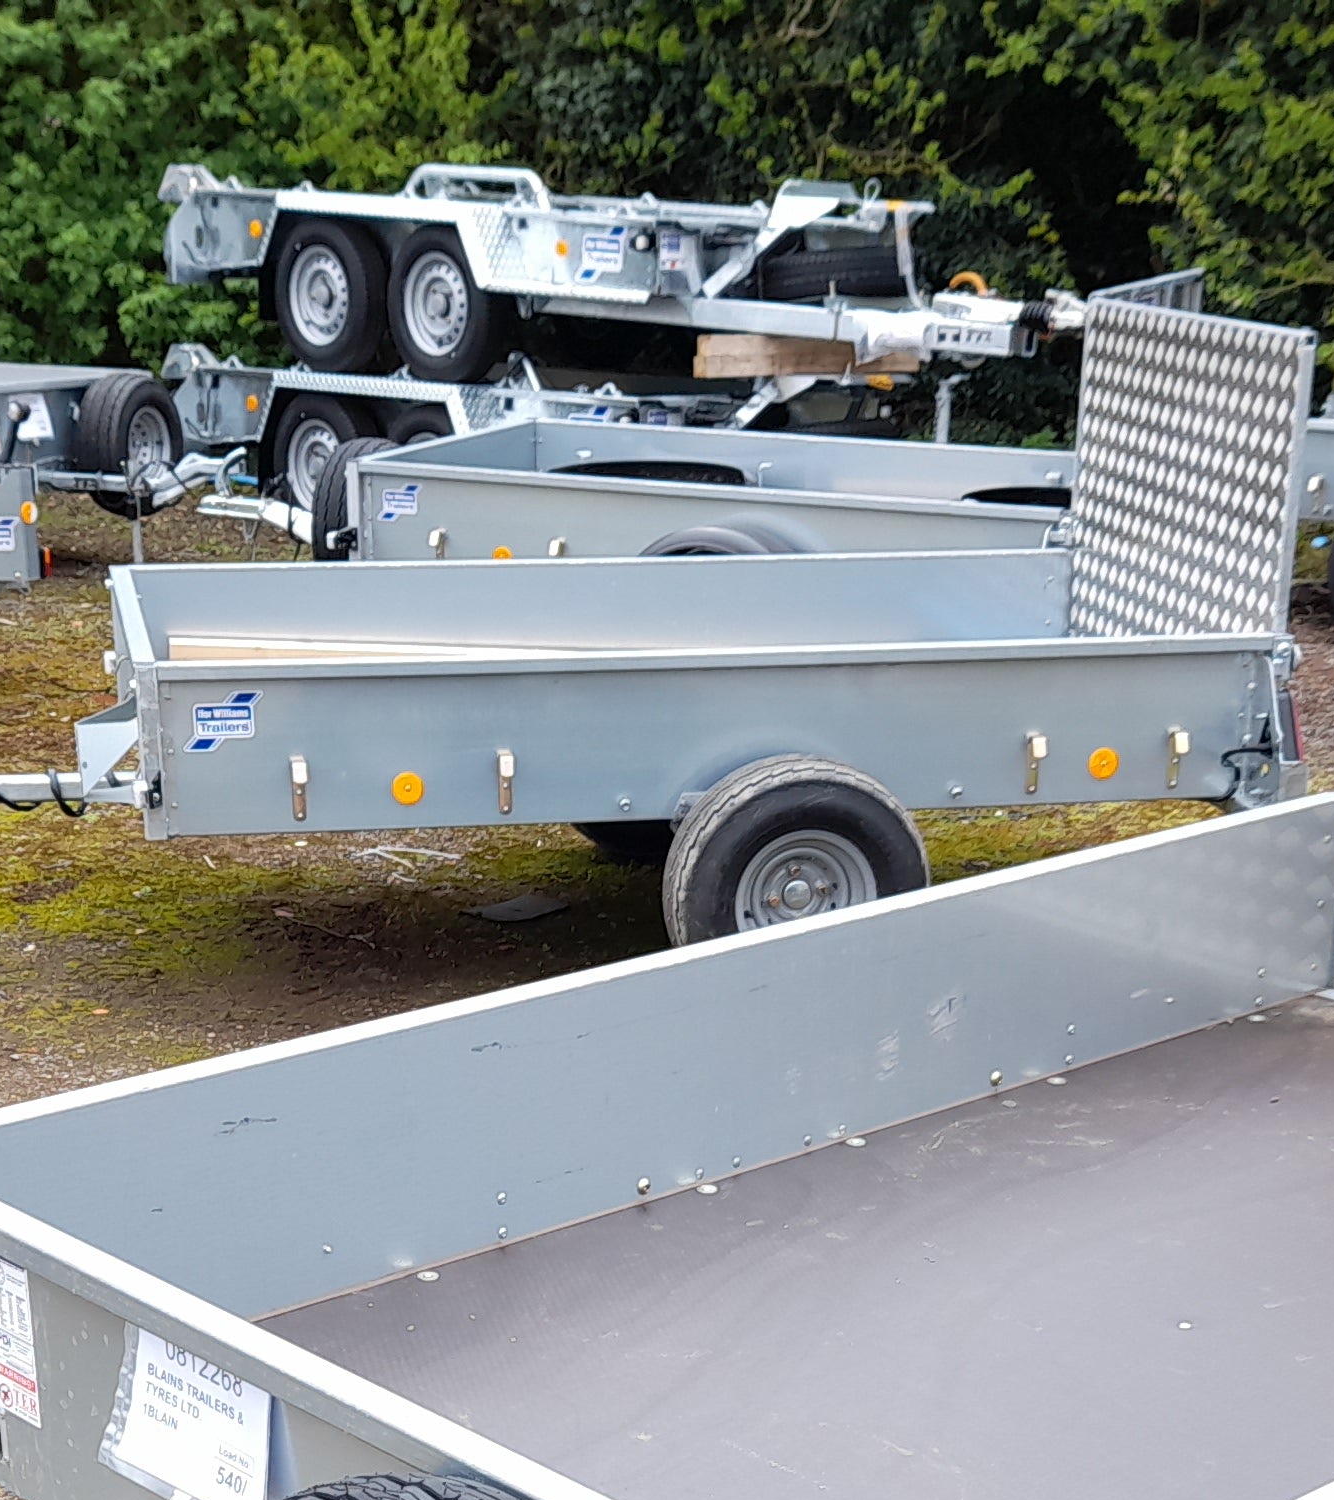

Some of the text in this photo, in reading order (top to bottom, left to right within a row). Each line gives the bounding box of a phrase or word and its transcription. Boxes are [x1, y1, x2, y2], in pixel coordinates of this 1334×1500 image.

[199, 722, 250, 733] Trailers
[145, 1381, 178, 1408] TYRES
[147, 1362, 244, 1425] BLAINS TRAILERS &
[143, 1402, 179, 1431] 1BLAIN
